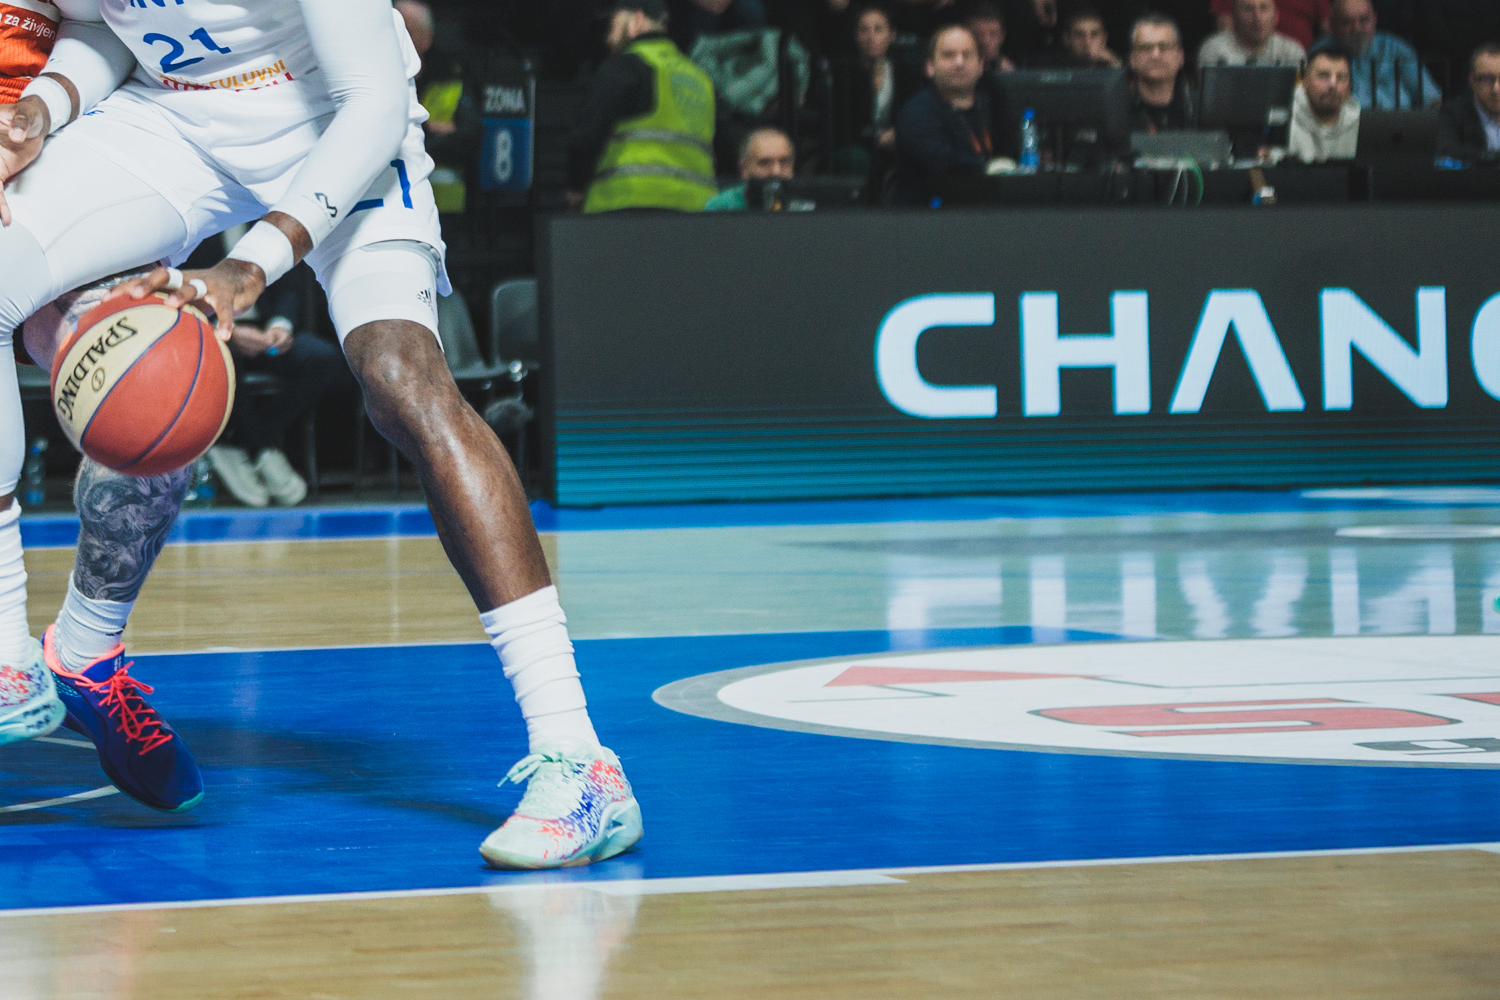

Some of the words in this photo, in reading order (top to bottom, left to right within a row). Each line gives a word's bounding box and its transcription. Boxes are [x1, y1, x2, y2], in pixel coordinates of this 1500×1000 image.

[4, 14, 20, 27] za
[143, 27, 232, 74] 21
[495, 128, 513, 183] 8
[57, 316, 138, 421] SPALDING
